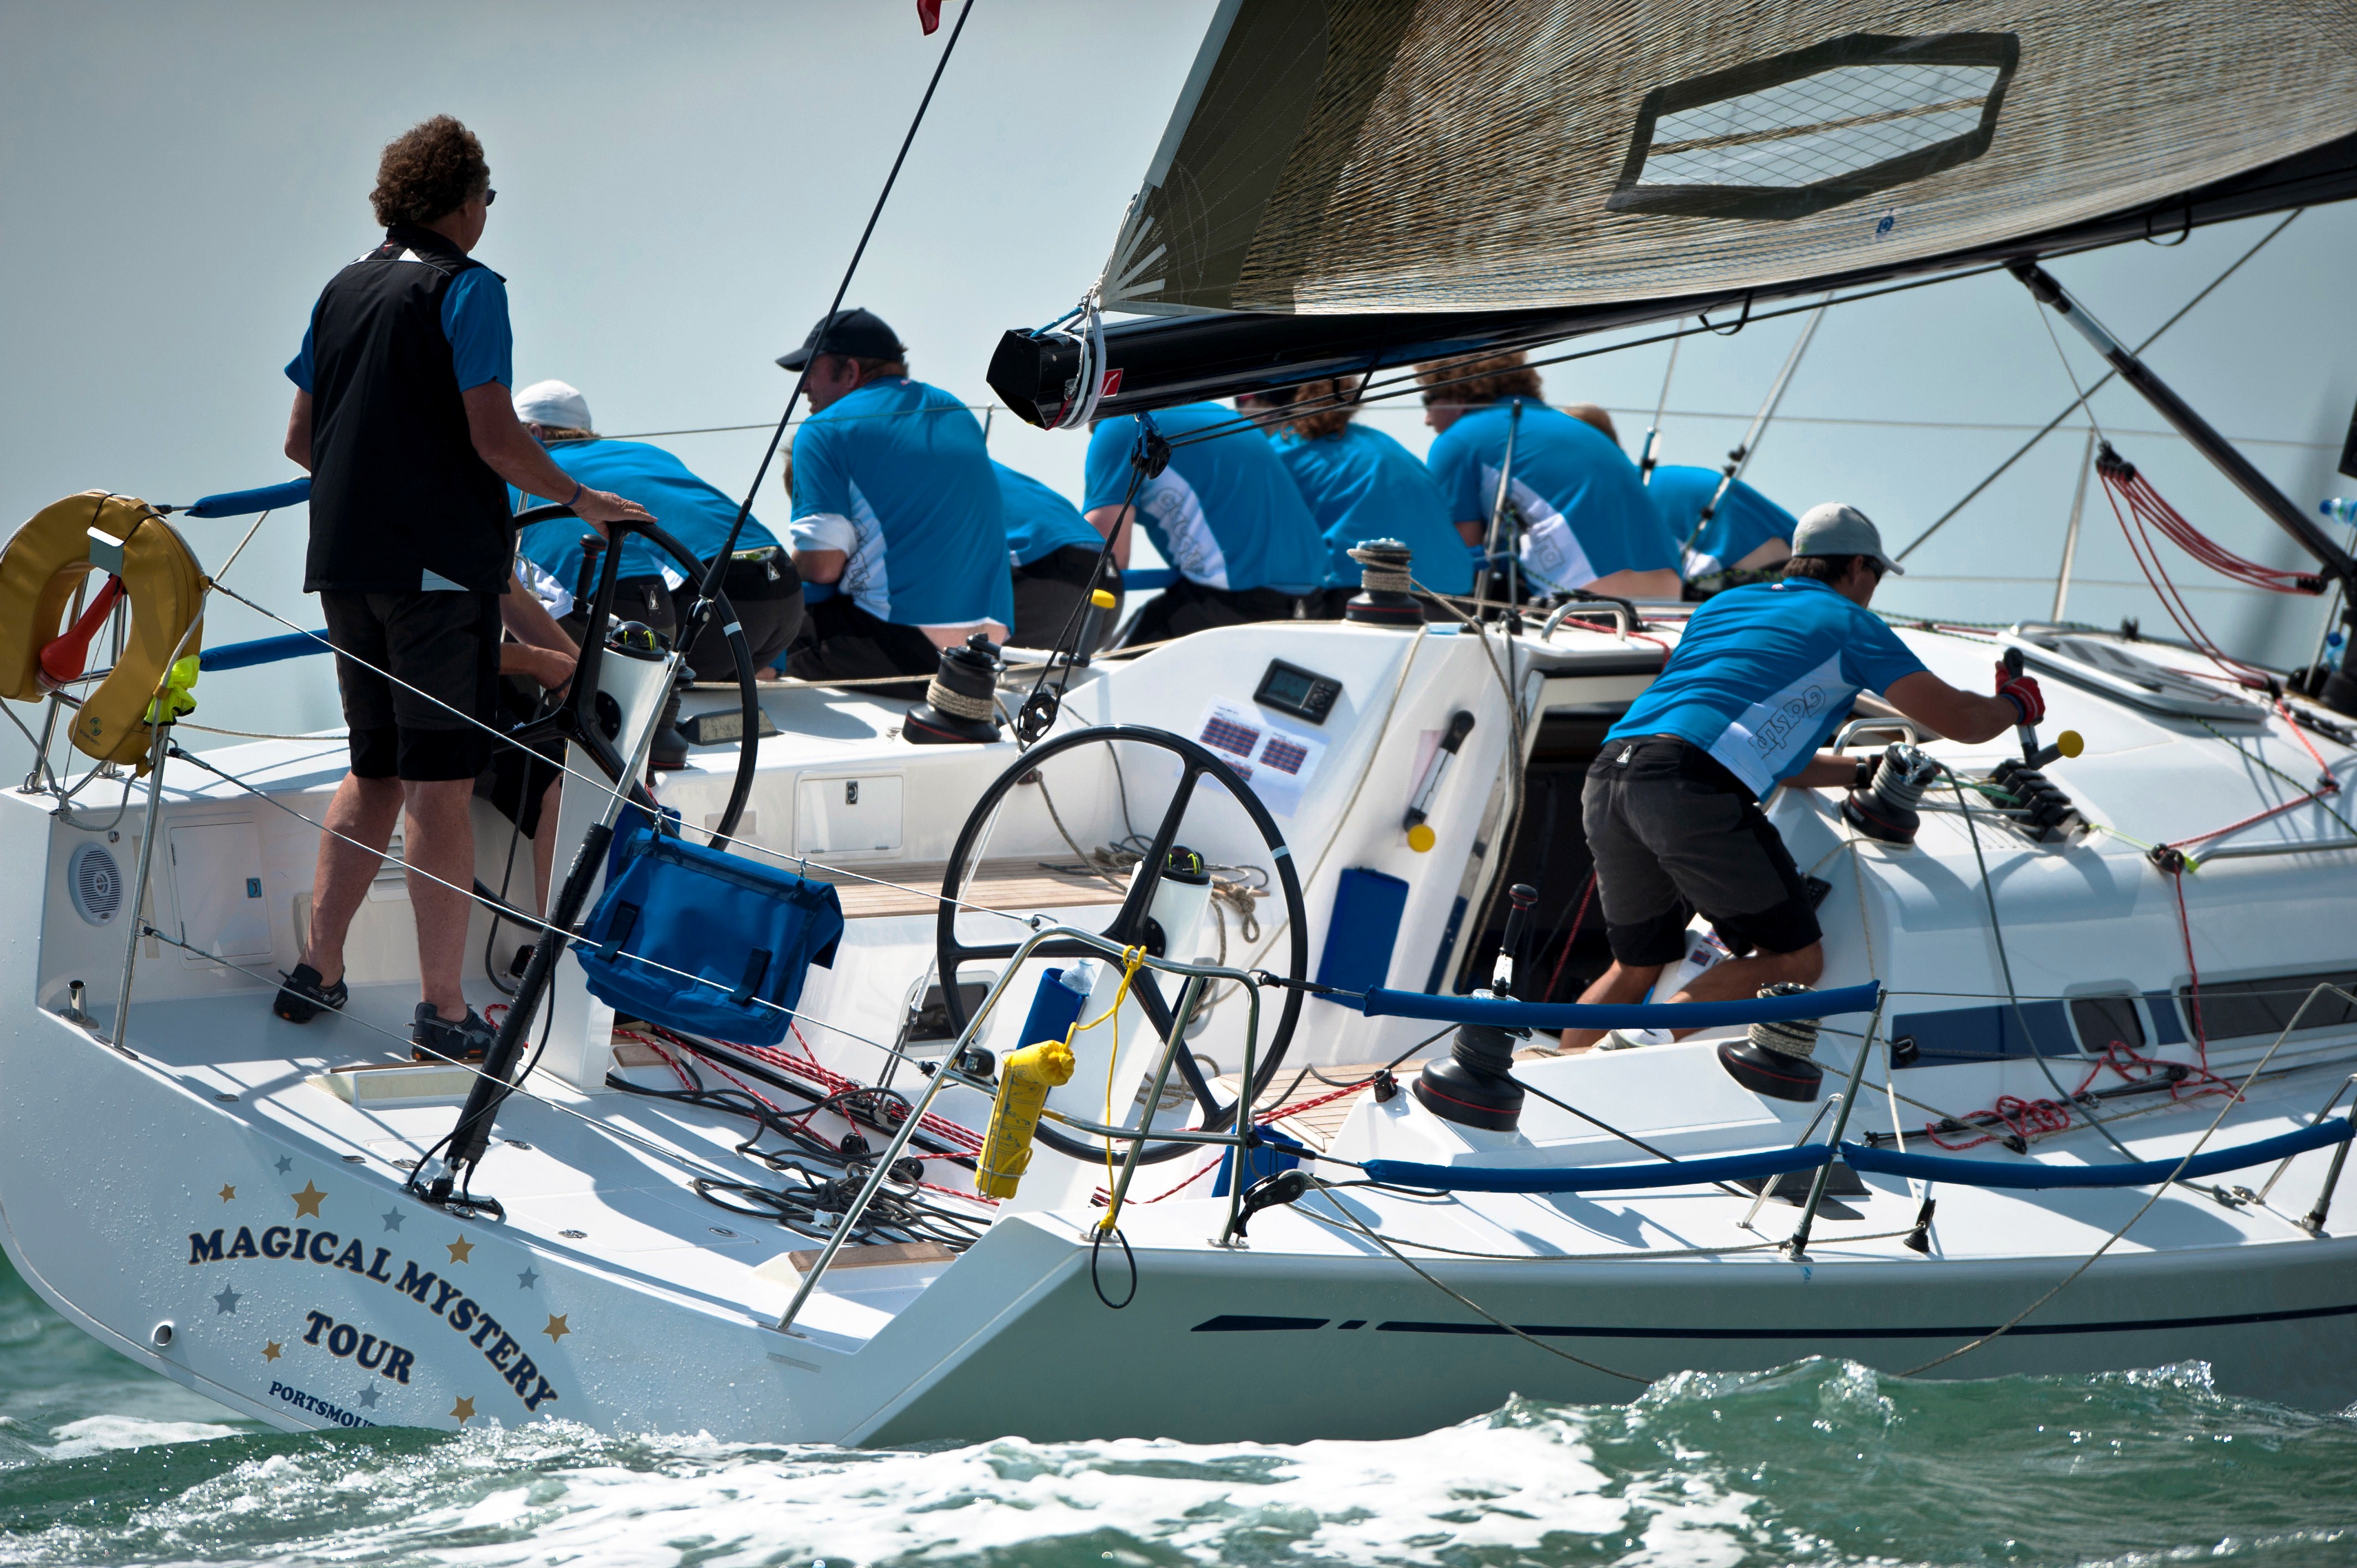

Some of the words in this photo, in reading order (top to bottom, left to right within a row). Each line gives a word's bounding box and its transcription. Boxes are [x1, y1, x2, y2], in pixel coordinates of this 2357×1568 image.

[188, 1225, 392, 1285] MAGICAL
[394, 1260, 559, 1413] MYSTERY
[302, 1309, 415, 1385] TOUR
